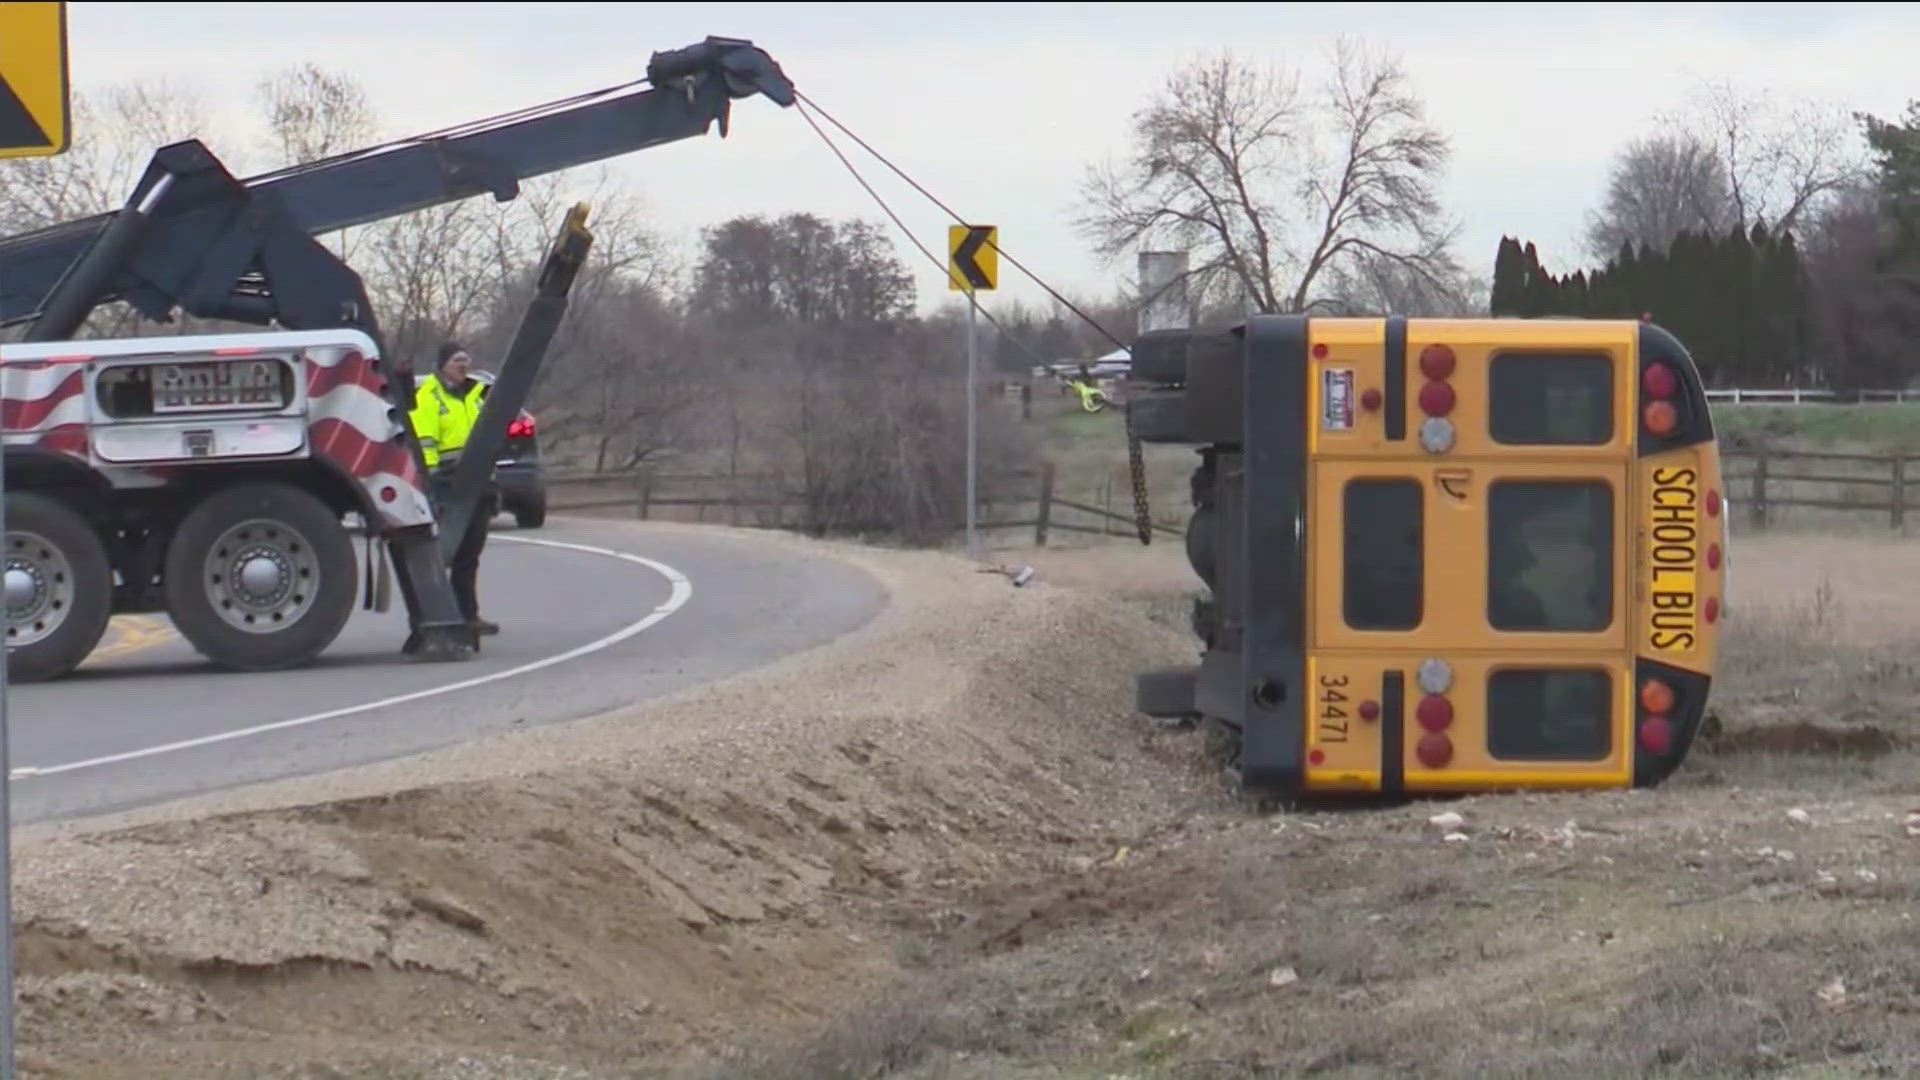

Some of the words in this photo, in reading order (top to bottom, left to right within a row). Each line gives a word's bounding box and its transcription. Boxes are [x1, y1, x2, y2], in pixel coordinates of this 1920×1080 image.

[1653, 468, 1696, 582] SCHOOL
[1651, 591, 1694, 649] BUS
[1320, 675, 1349, 743] 34471
